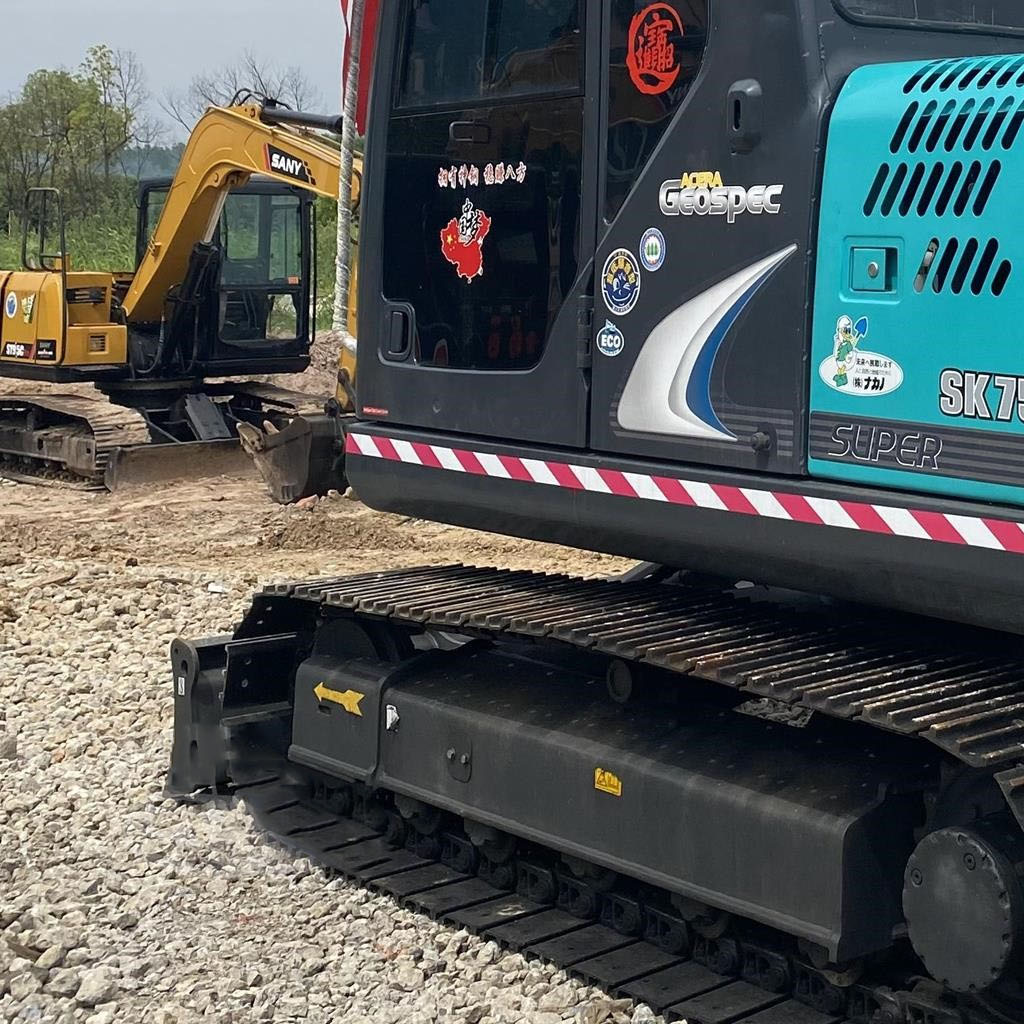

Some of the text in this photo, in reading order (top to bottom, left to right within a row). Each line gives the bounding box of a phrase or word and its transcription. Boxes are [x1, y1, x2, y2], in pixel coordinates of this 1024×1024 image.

[271, 153, 302, 176] SANY
[601, 334, 621, 349] ECO
[828, 424, 943, 470] SUPER
